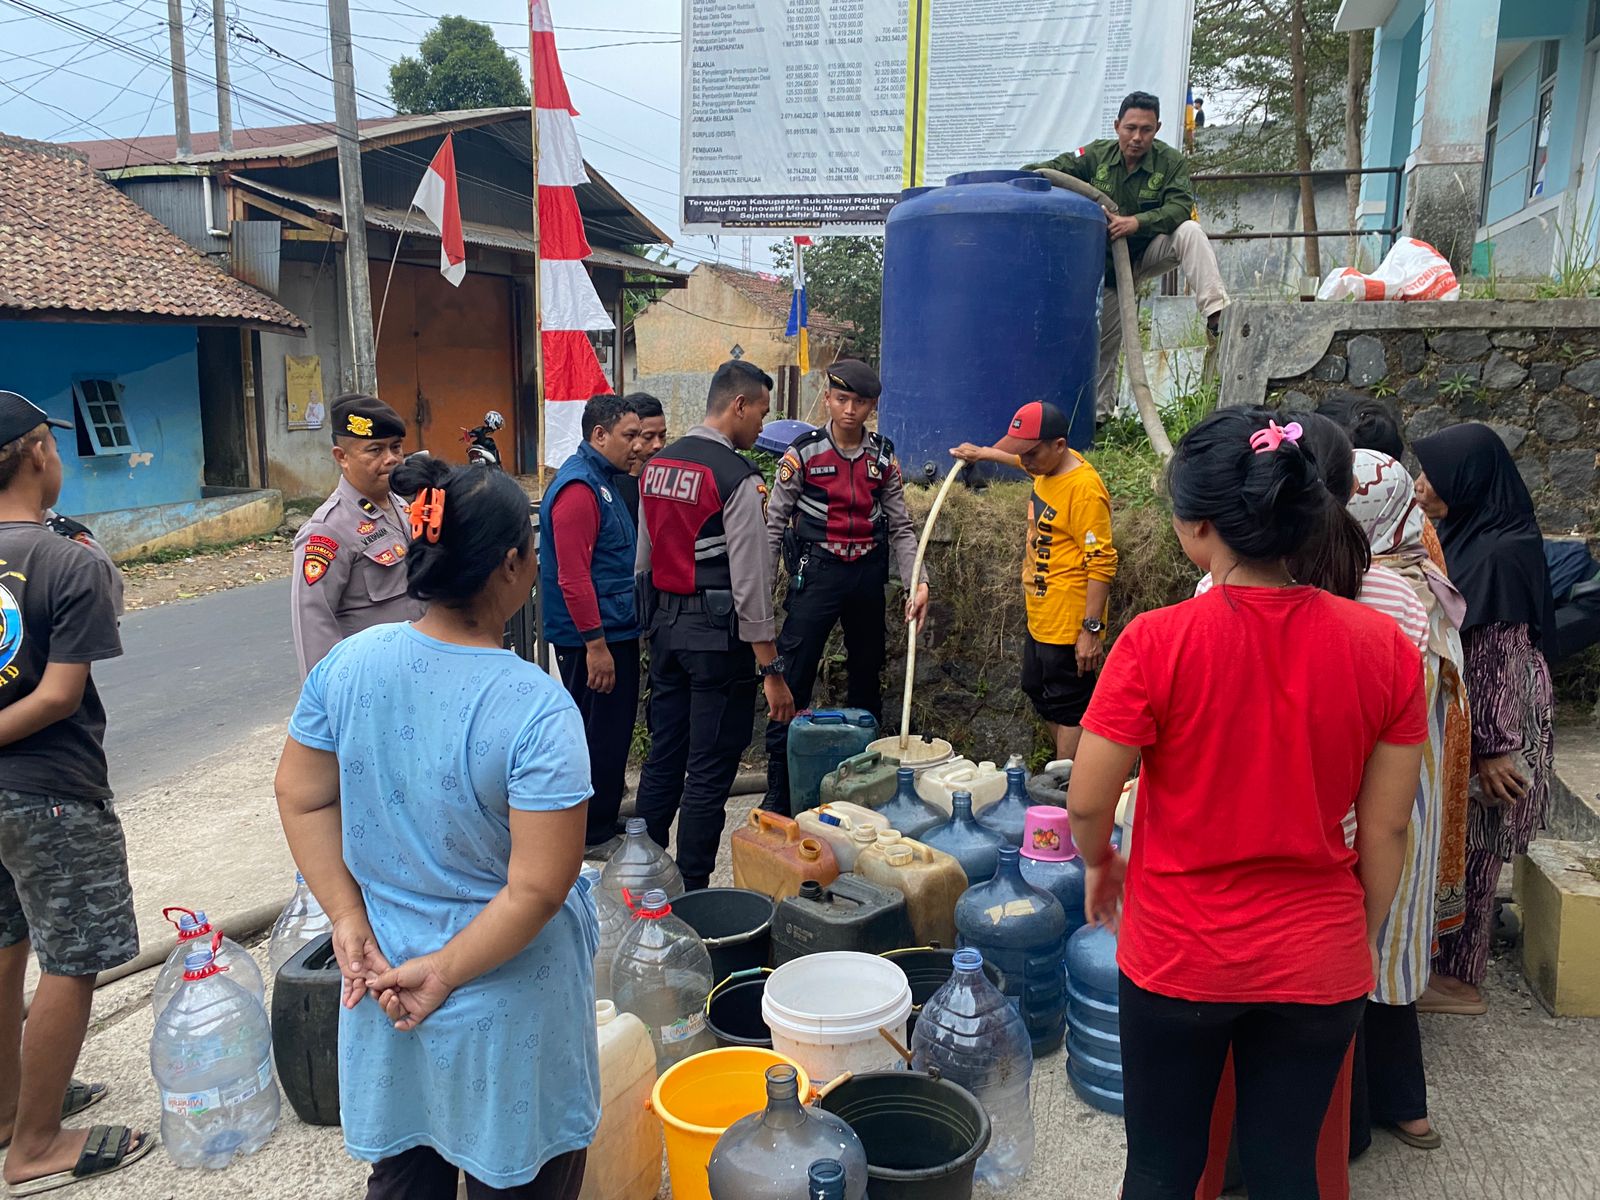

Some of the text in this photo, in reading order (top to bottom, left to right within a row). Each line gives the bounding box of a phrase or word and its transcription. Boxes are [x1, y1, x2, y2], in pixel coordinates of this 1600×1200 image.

[854, 197, 898, 205] Religius,
[704, 206, 726, 214] Maju
[644, 466, 701, 501] POLISI
